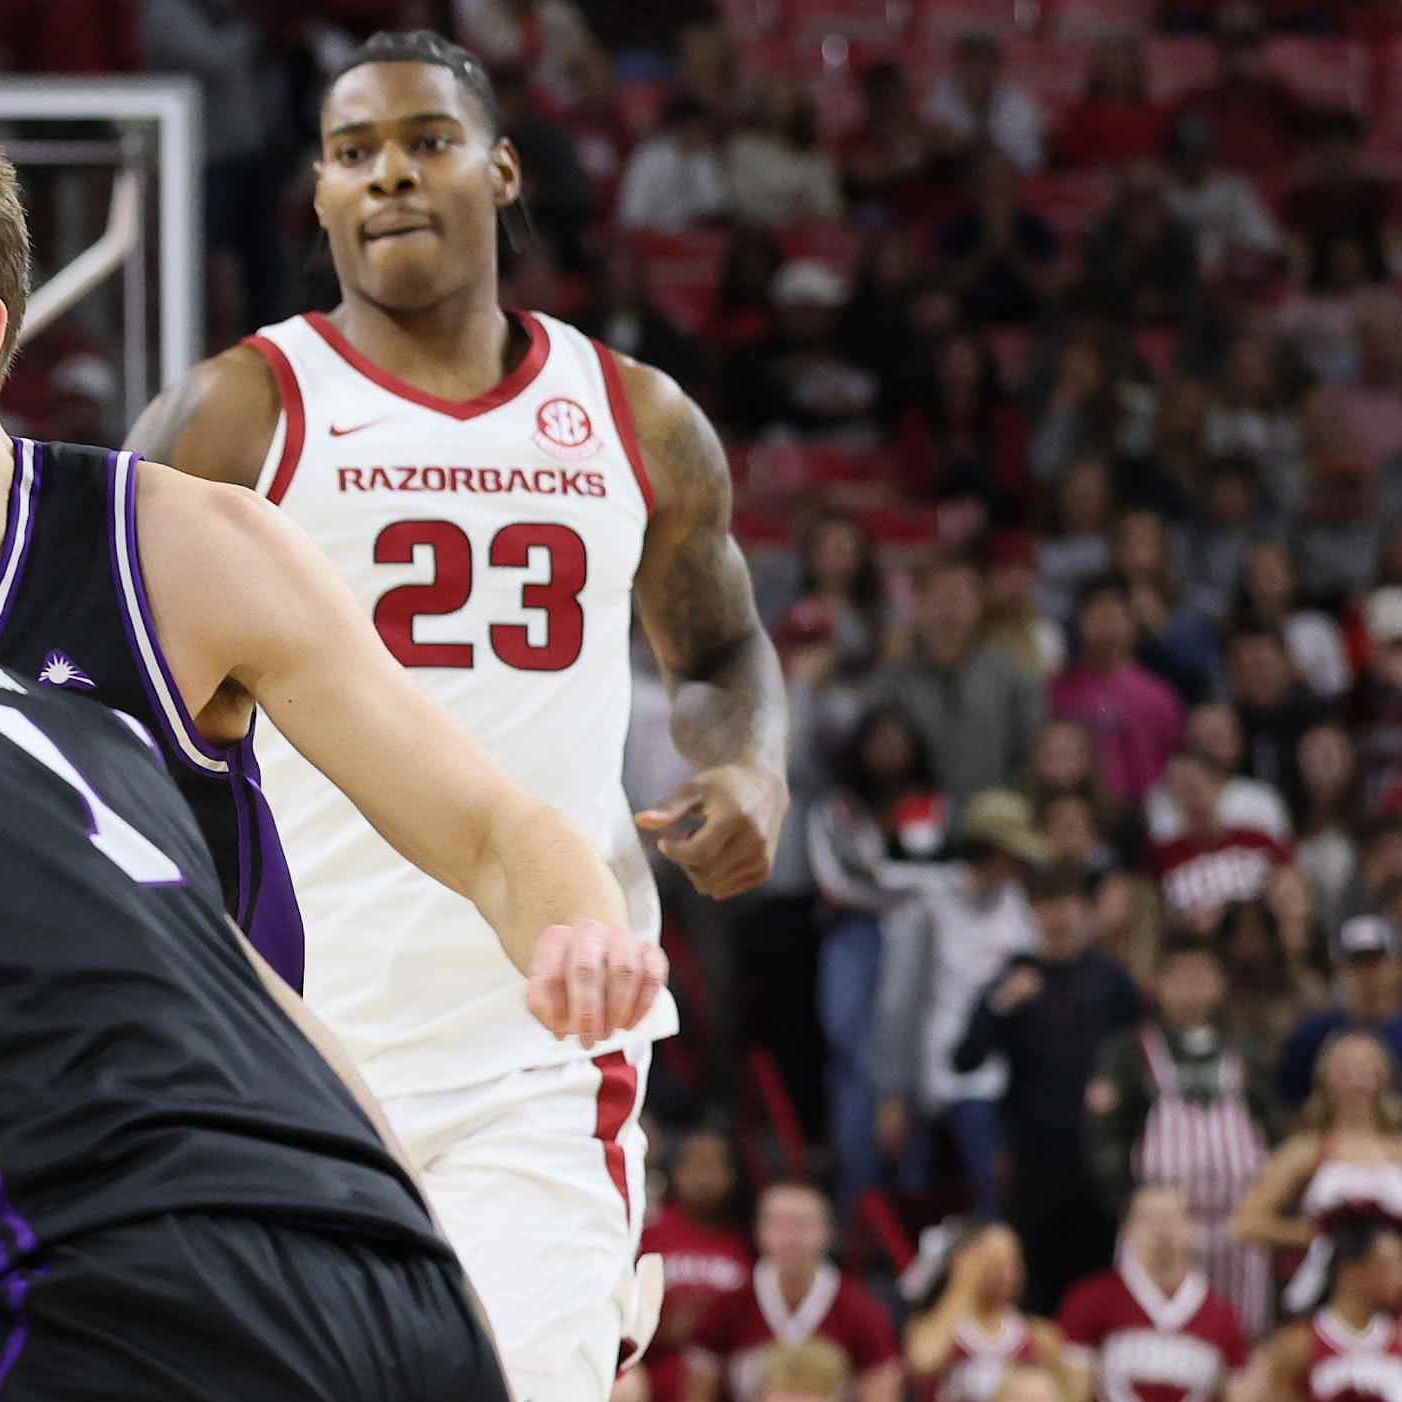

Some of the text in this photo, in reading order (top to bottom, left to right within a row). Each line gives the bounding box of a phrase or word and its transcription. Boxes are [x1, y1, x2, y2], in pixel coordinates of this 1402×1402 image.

[538, 400, 591, 444] SEC
[337, 466, 607, 498] RAZORBACKS
[373, 519, 587, 671] 23
